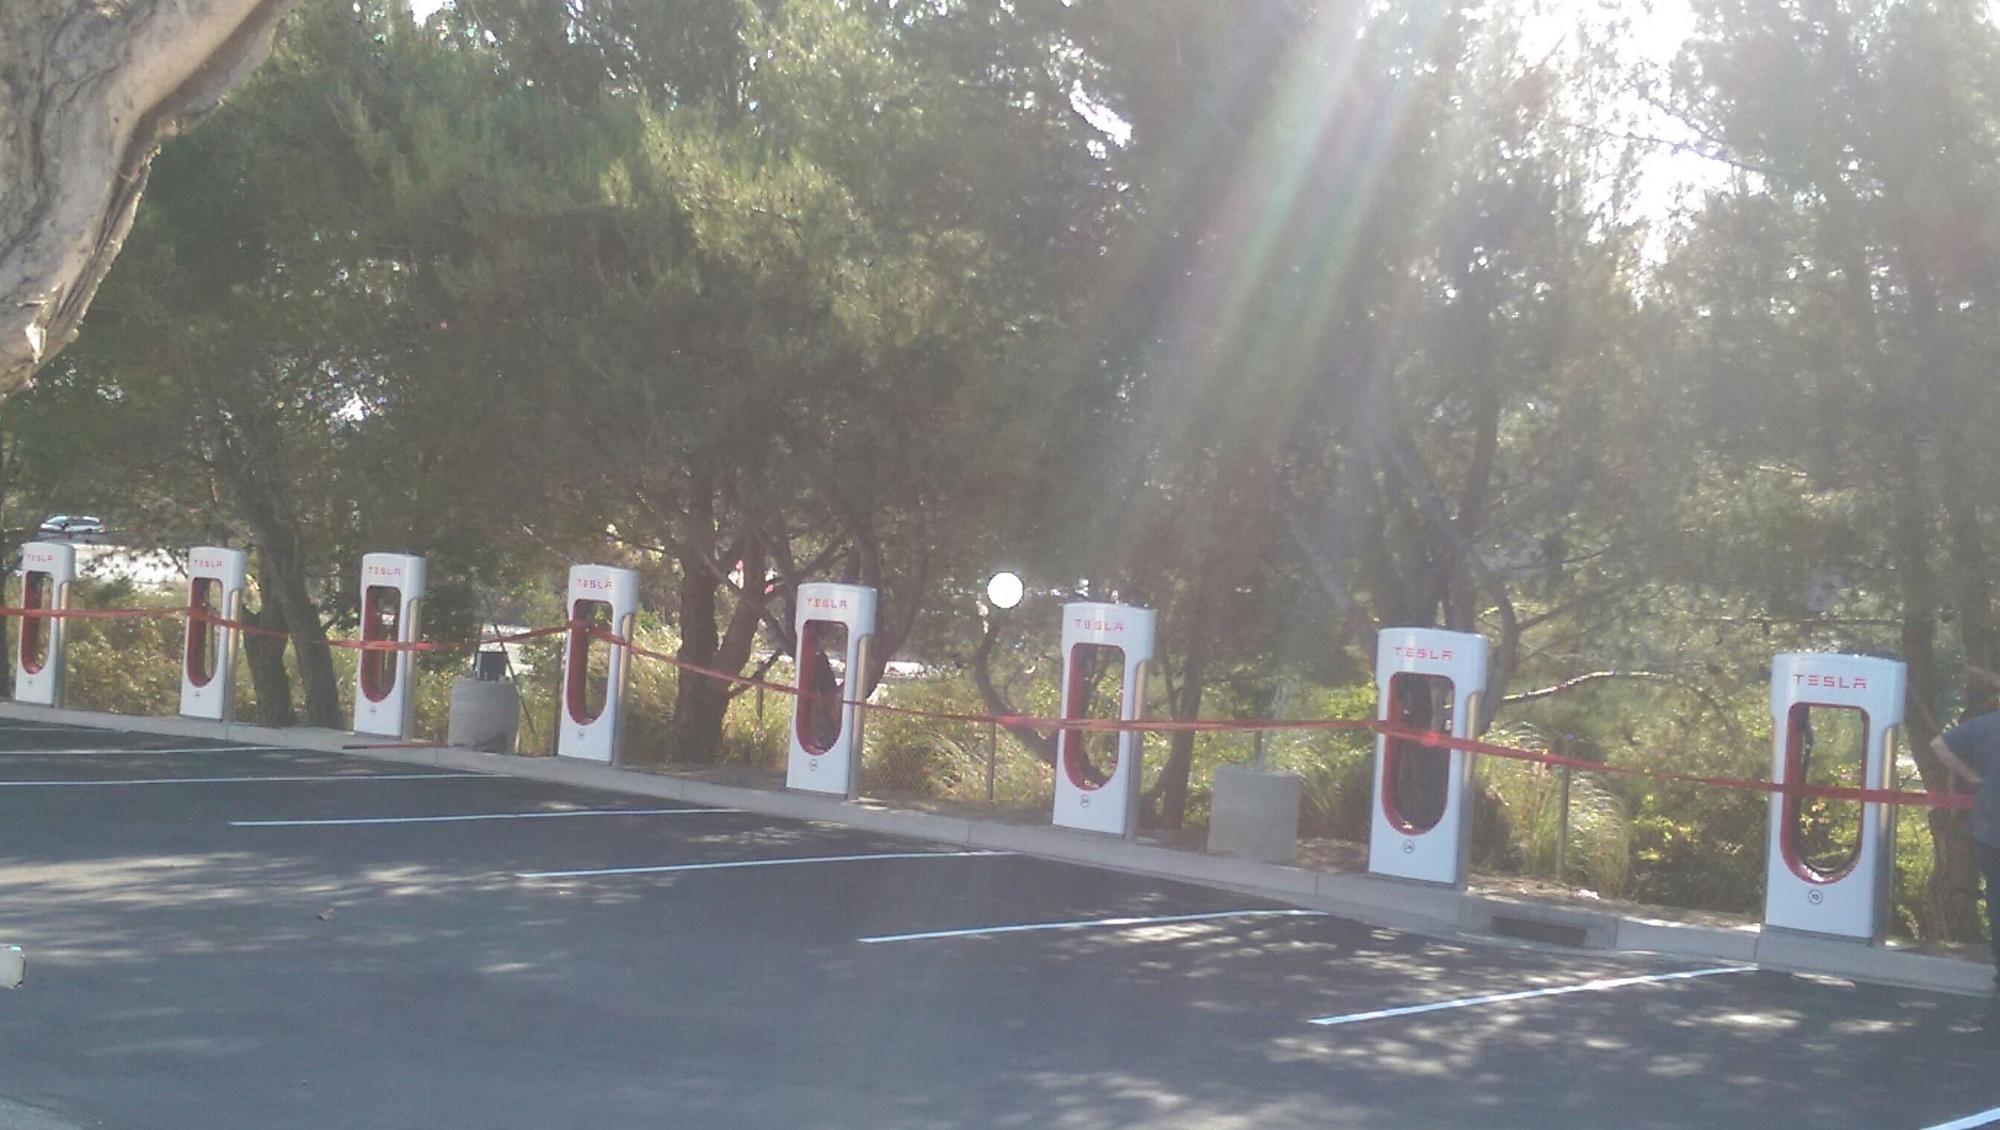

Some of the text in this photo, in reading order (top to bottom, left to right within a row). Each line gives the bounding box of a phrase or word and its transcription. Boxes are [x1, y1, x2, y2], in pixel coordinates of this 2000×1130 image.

[193, 559, 223, 568] TESLA
[368, 566, 401, 576] TESLA
[577, 579, 613, 589] TESLA
[807, 598, 848, 609] TESLA
[1073, 619, 1124, 631] TESLA
[1394, 647, 1453, 660] TESLA
[1794, 673, 1867, 689] TESLA
